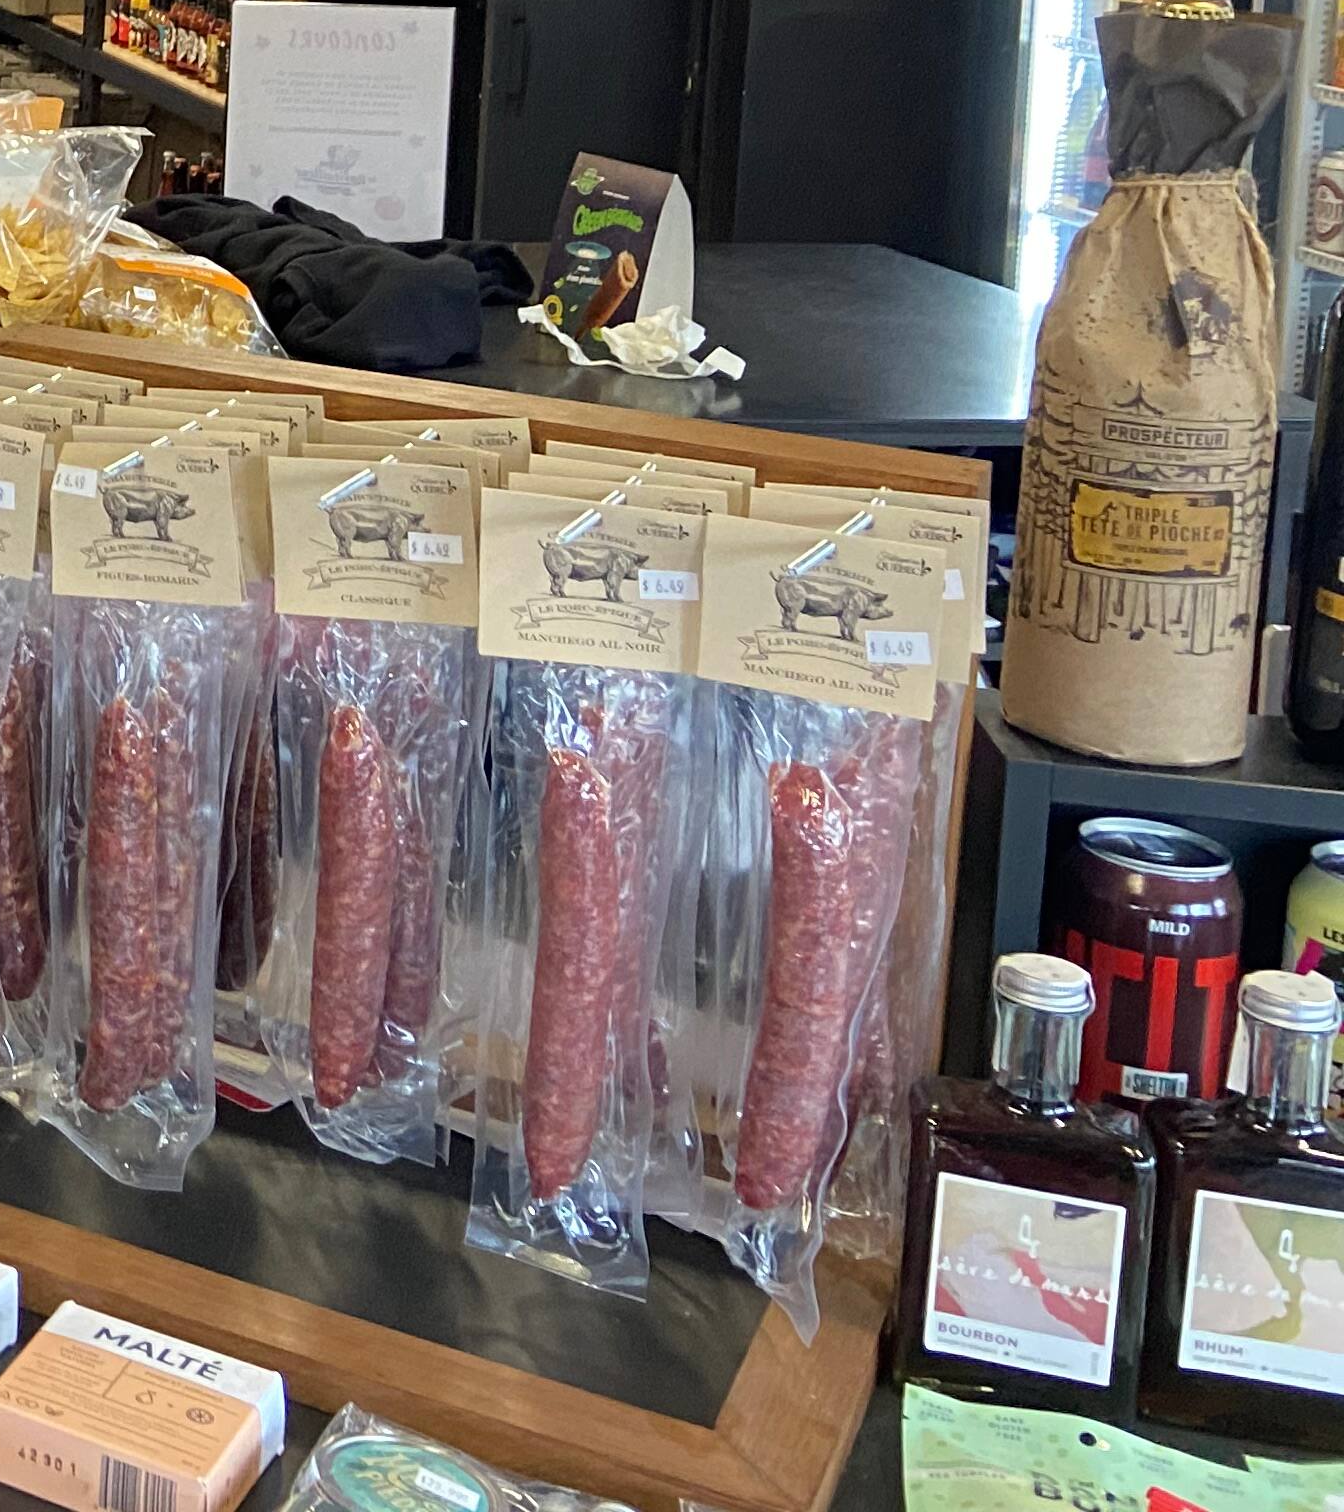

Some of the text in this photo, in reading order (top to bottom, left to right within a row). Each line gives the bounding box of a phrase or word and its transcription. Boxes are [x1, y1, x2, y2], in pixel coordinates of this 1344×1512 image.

[1106, 424, 1225, 448] PROSPECTEUR
[1125, 504, 1181, 524] TRIPLE
[1149, 526, 1212, 542] PIOCHE
[340, 593, 412, 608] CLASSIQUE
[517, 631, 662, 655] MANCHEGO AIL NOIR
[743, 660, 896, 698] MANCHEGO AIL NOIR
[1148, 918, 1192, 937] MILD
[937, 1320, 1020, 1349] BOURBON
[93, 1326, 225, 1382] MALTÉ
[1193, 1339, 1244, 1357] RHUM
